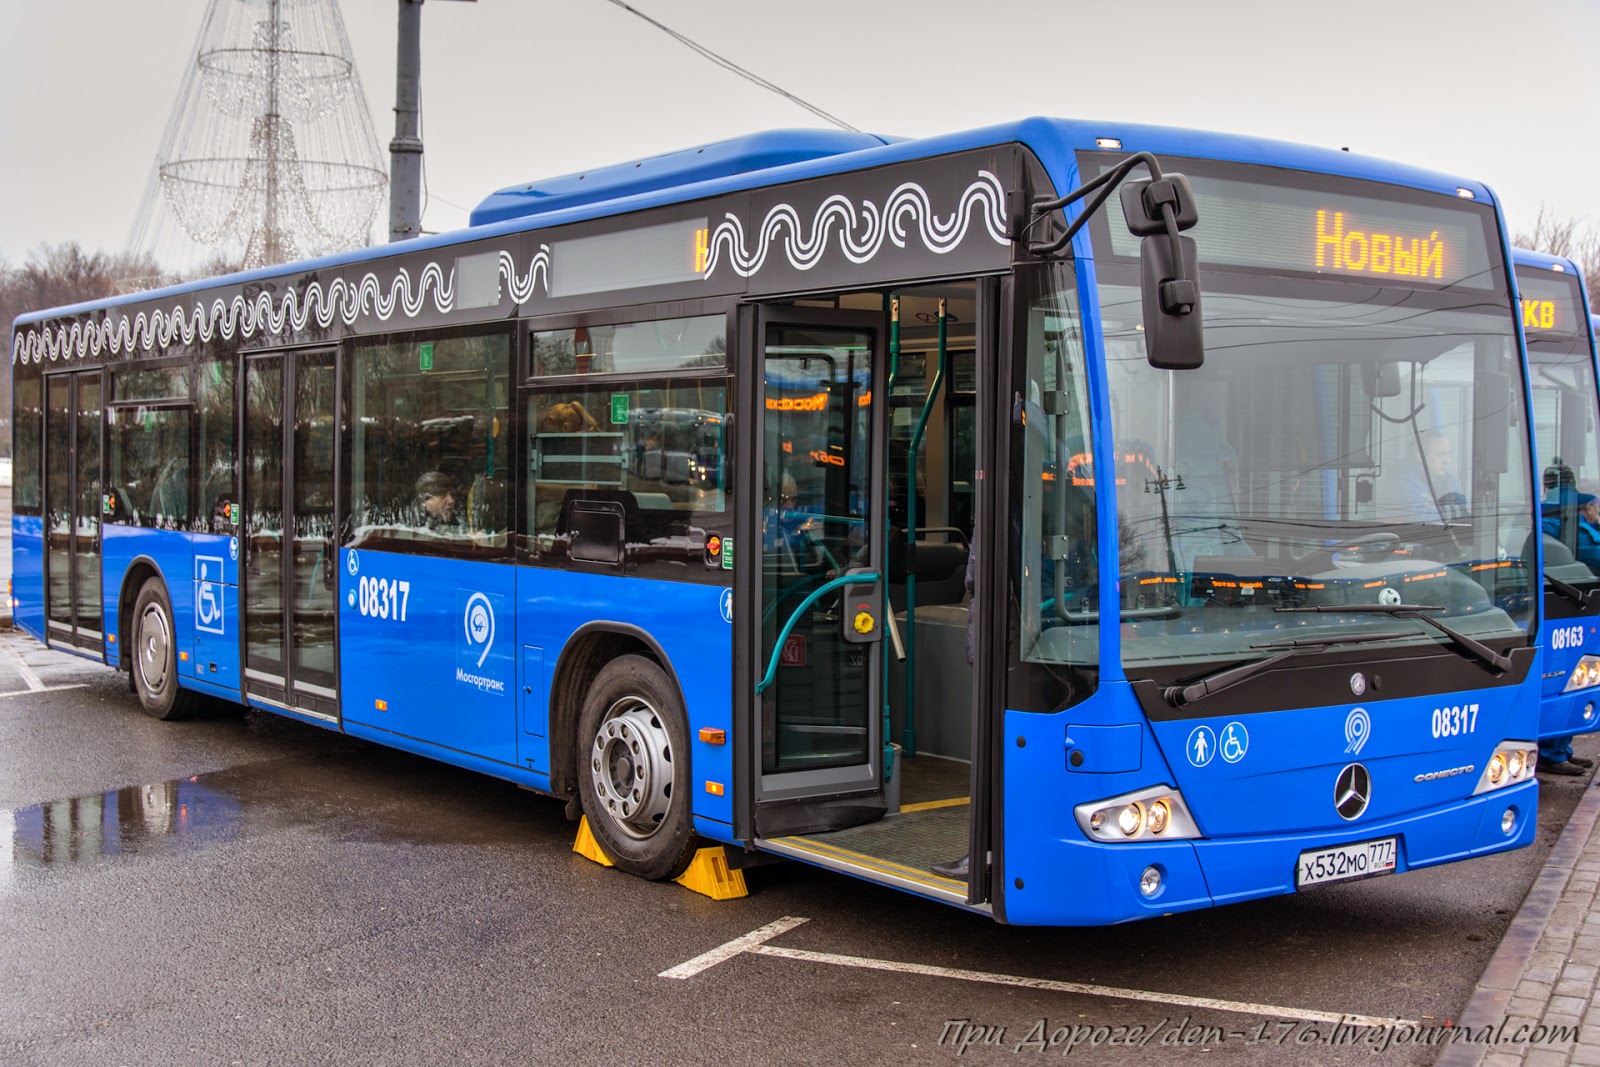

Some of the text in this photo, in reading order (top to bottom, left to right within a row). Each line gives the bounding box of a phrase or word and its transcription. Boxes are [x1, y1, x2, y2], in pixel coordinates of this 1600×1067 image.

[1316, 210, 1443, 278] Новый
[359, 576, 410, 622] 08317
[1552, 626, 1583, 650] 08163
[456, 667, 504, 691] Мосгортранс
[1432, 704, 1479, 739] 08317
[1414, 765, 1474, 783] CONECTO
[1370, 842, 1391, 862] 777
